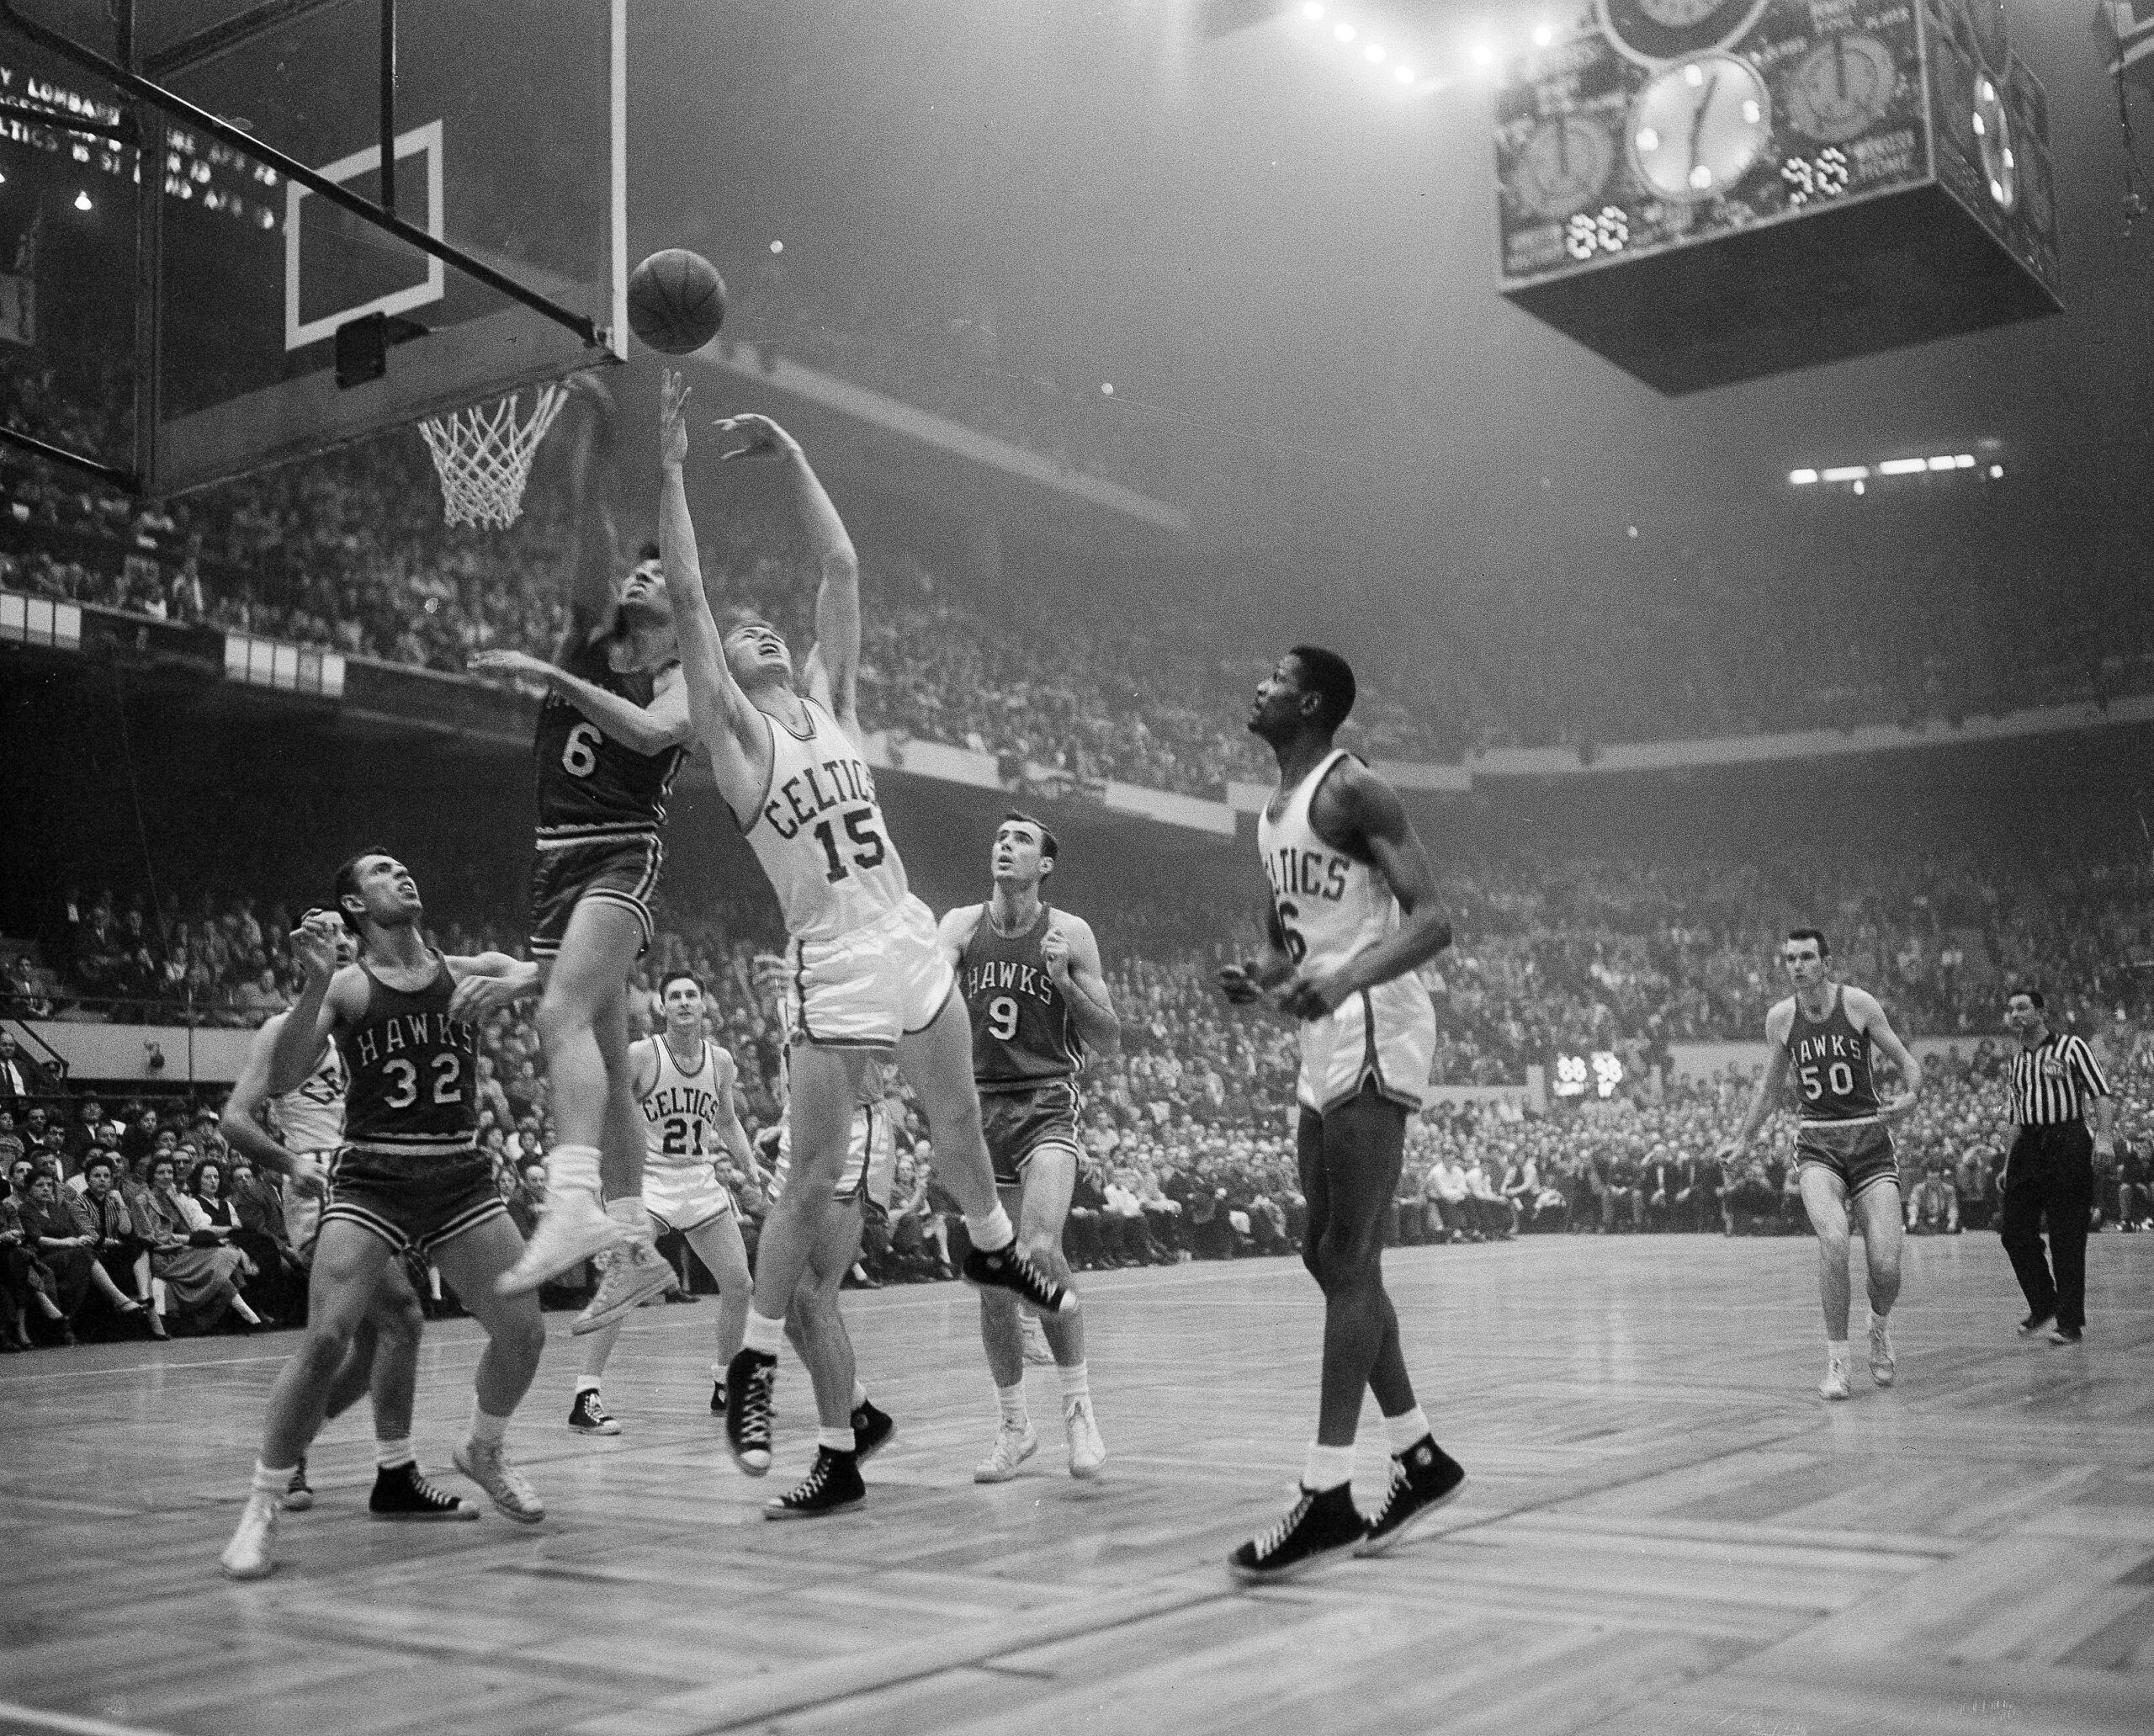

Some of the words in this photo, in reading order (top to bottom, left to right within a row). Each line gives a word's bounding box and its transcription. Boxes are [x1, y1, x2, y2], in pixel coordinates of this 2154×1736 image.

[561, 722, 603, 777] 6
[814, 807, 884, 884] 15
[1279, 901, 1306, 964] 6
[968, 960, 1053, 1006] HAWKS
[357, 1013, 472, 1066] HAWKS
[988, 995, 1019, 1040] 9
[382, 1053, 461, 1108] 32
[642, 1086, 718, 1124] CELTICS
[1800, 1061, 1854, 1100] 50
[663, 1118, 703, 1155] 21
